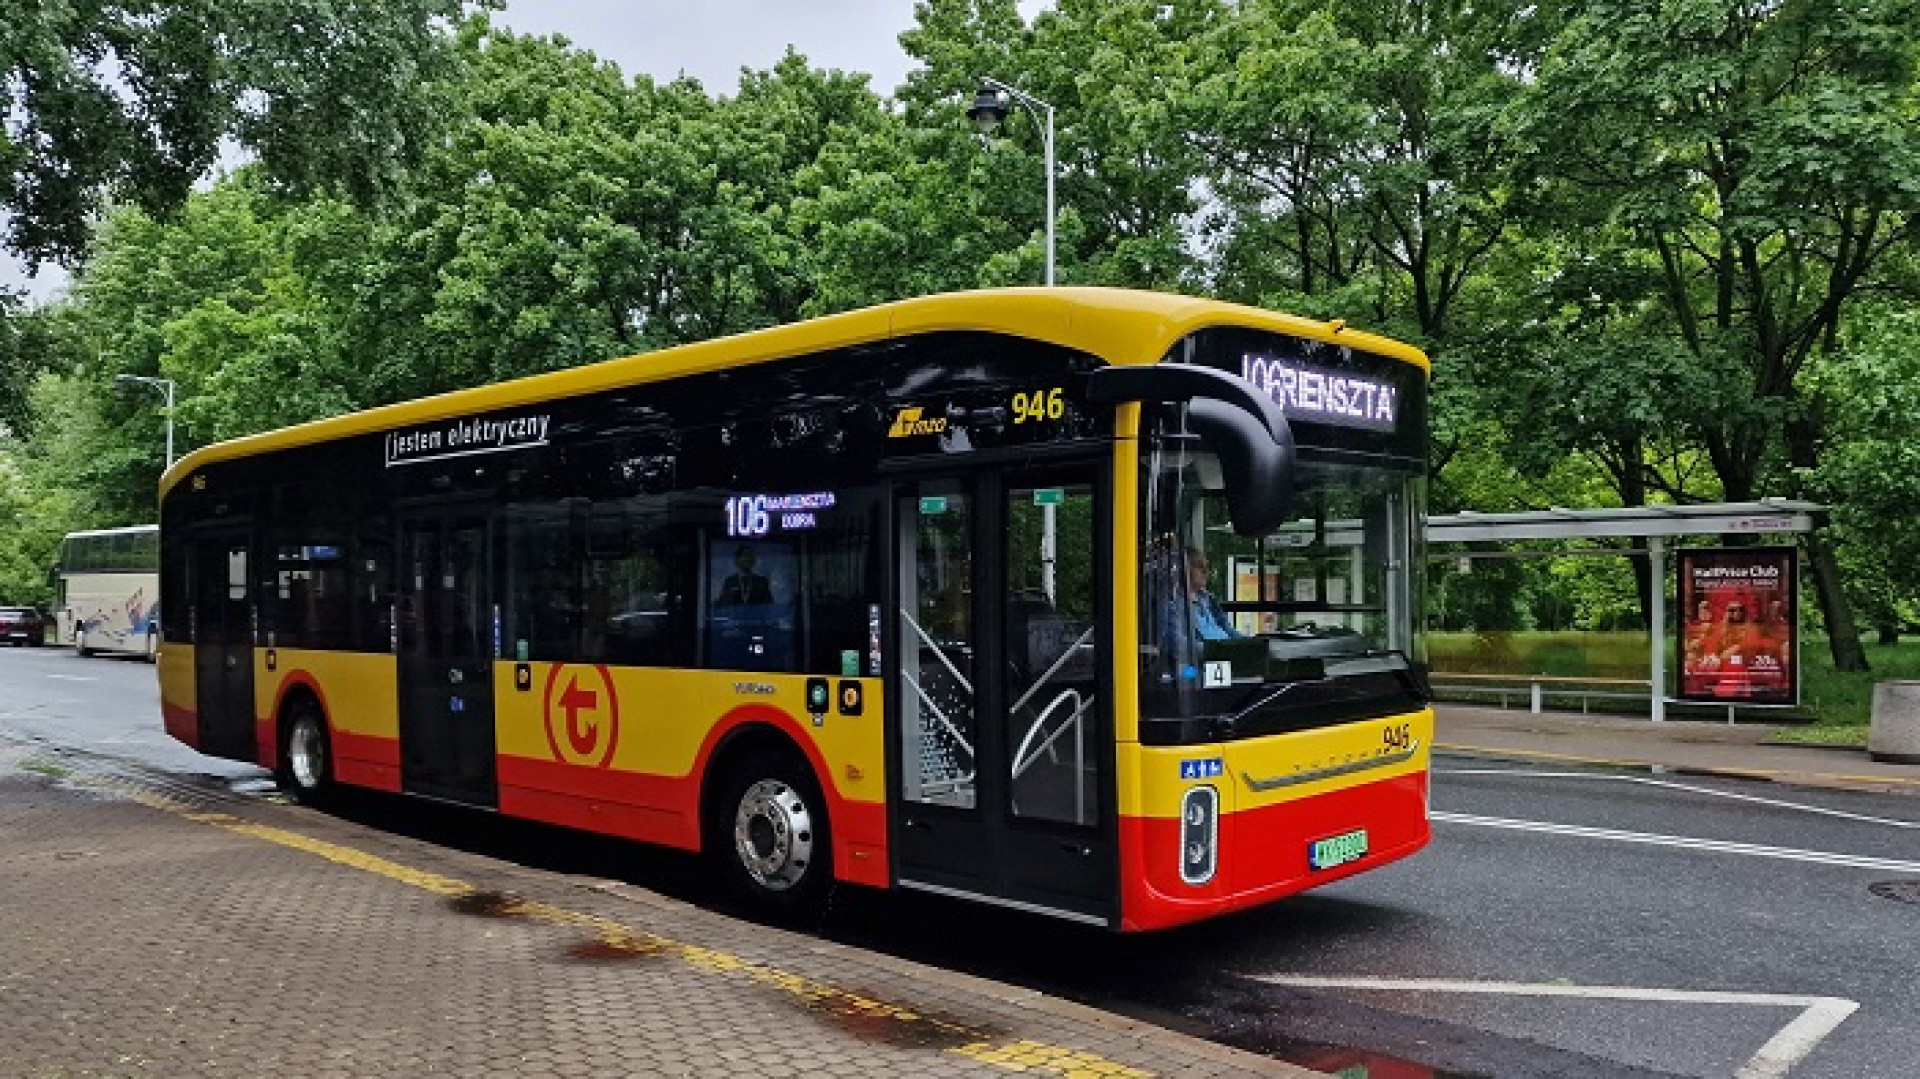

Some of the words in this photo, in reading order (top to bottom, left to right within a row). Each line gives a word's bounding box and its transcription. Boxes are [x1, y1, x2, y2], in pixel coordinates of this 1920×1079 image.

[1012, 387, 1064, 424] 946
[390, 431, 441, 460] jestem
[448, 415, 550, 446] elektryczny
[725, 495, 769, 536] 106
[1750, 564, 1779, 577] Club
[1213, 663, 1224, 684] 4
[1383, 724, 1410, 754] 946
